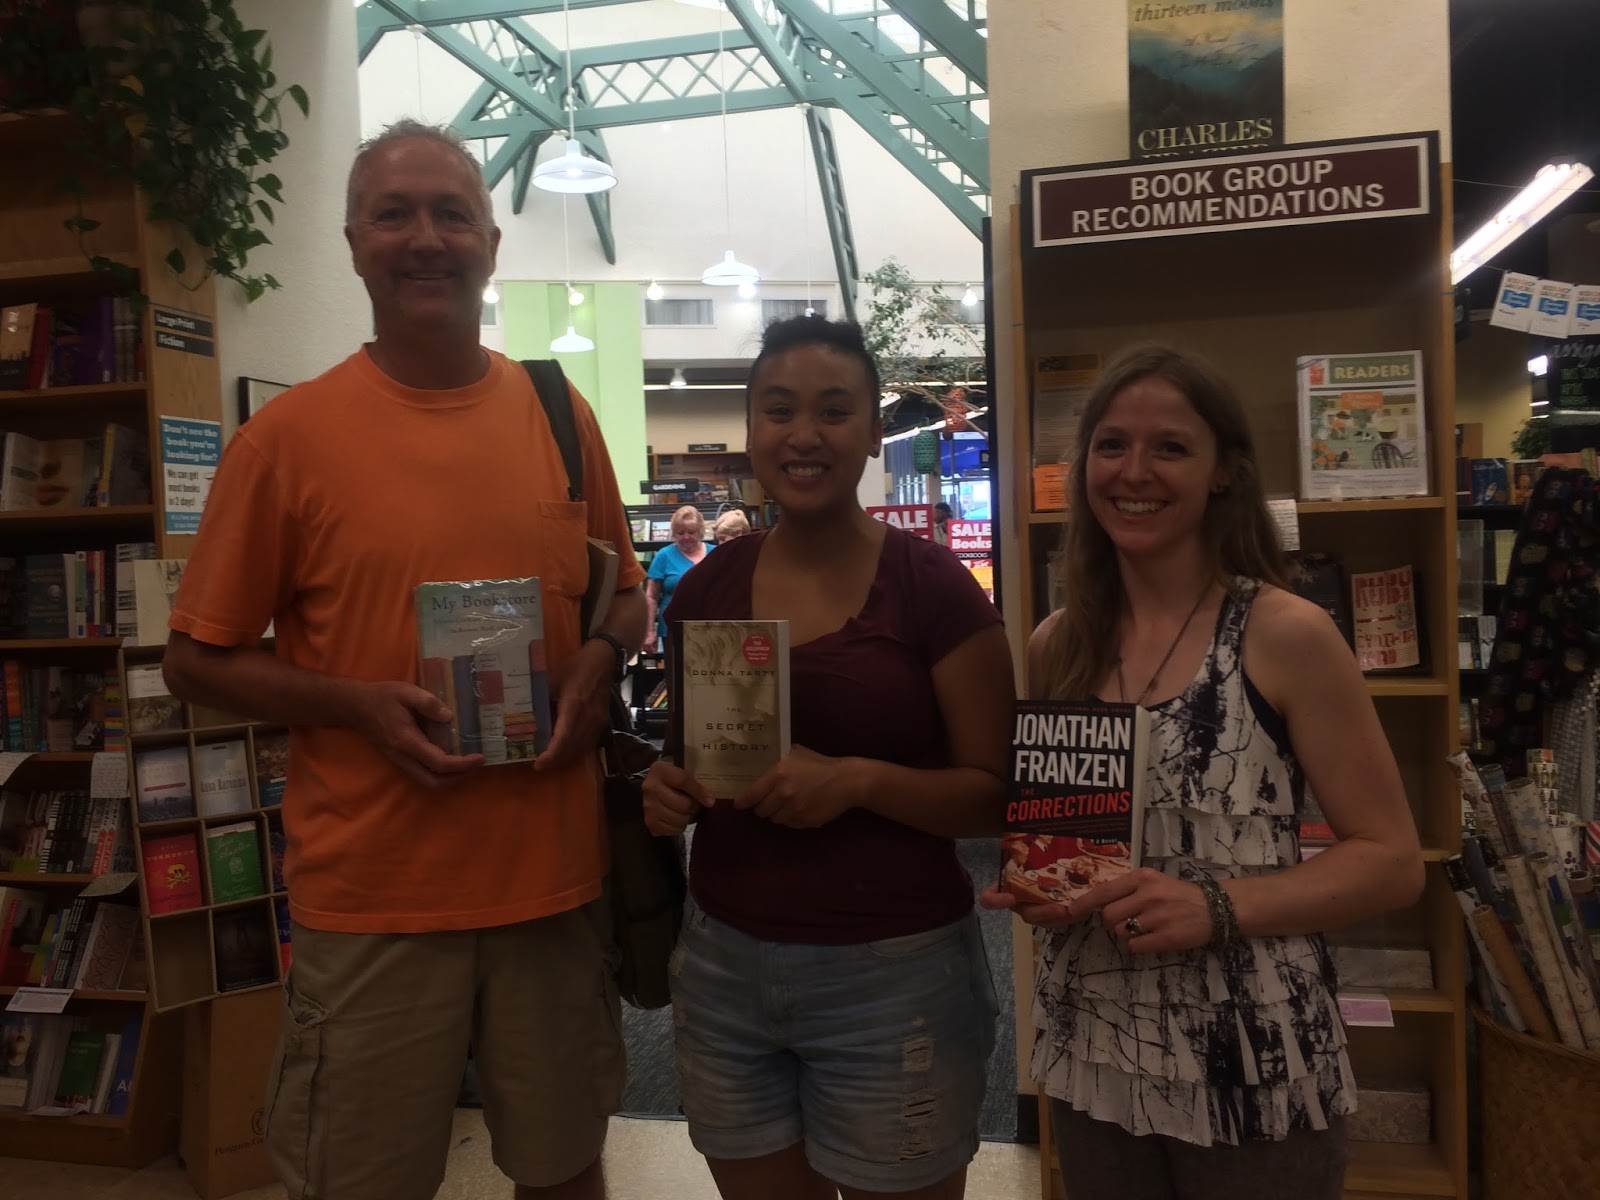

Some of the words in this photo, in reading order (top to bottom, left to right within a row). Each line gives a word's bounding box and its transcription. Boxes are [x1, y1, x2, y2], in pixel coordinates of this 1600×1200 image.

[1134, 3, 1207, 21] thirteen
[1137, 118, 1274, 150] CHARLES
[1130, 168, 1213, 201] BOOK
[1223, 159, 1334, 190] GROUP
[1072, 183, 1385, 233] RECOMMENDATIONS
[158, 333, 185, 348] Fiction
[1334, 364, 1410, 379] READERS
[162, 424, 188, 434] Don't
[189, 428, 203, 436] see
[204, 429, 218, 437] the
[166, 437, 188, 447] book
[166, 450, 199, 462] looking
[872, 510, 928, 530] SALE
[951, 522, 992, 537] SALE
[951, 537, 992, 549] Books
[432, 597, 456, 613] My
[706, 722, 765, 731] SECRET
[1012, 713, 1132, 750] JONATHAN
[702, 743, 769, 751] HISTORY
[1014, 750, 1126, 788] FRANZEN
[1006, 791, 1132, 822] CORRECTIONS
